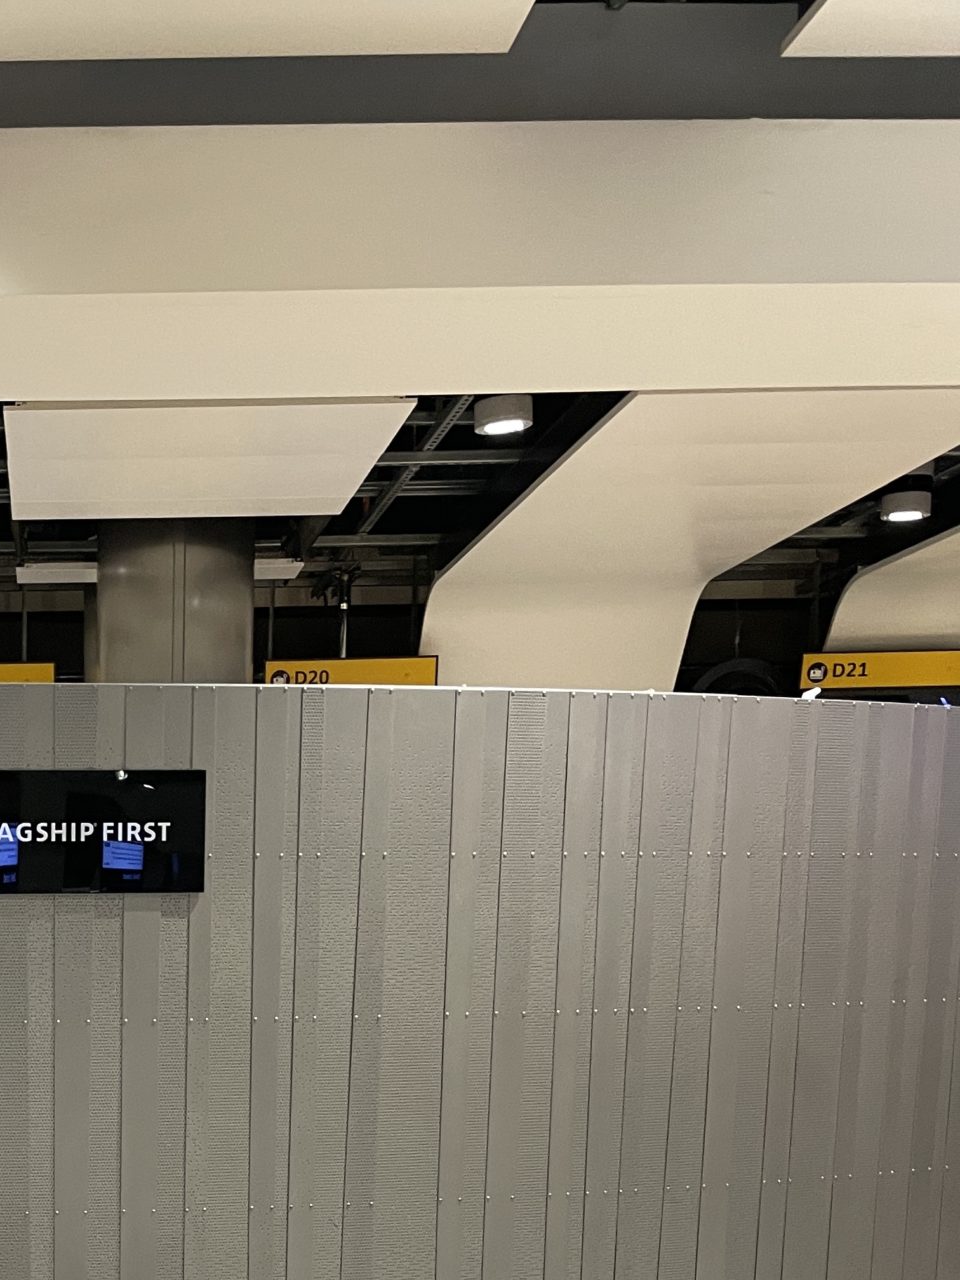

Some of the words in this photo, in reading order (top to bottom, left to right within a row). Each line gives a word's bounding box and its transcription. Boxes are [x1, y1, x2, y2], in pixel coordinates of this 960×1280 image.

[294, 669, 330, 685] D20
[832, 662, 868, 678] D21
[102, 822, 171, 842] FIRST
